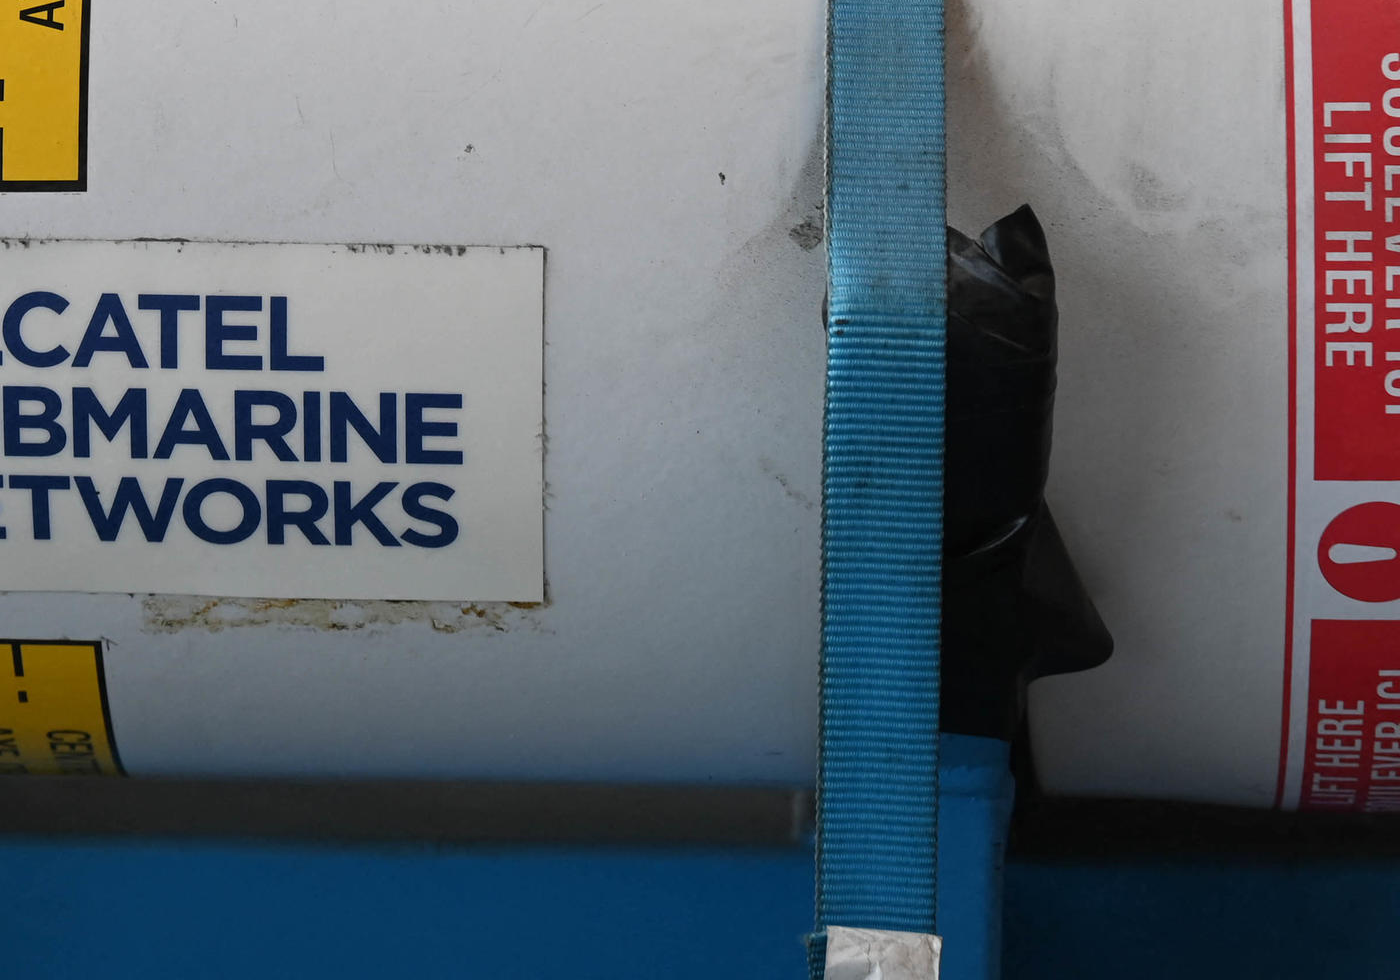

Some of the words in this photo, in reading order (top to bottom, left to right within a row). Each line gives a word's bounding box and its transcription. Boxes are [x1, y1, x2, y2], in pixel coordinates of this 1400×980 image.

[1322, 101, 1373, 212] LIFT
[1324, 230, 1374, 369] HERE
[1314, 699, 1365, 769] HERE
[1310, 774, 1358, 804] LIFT
